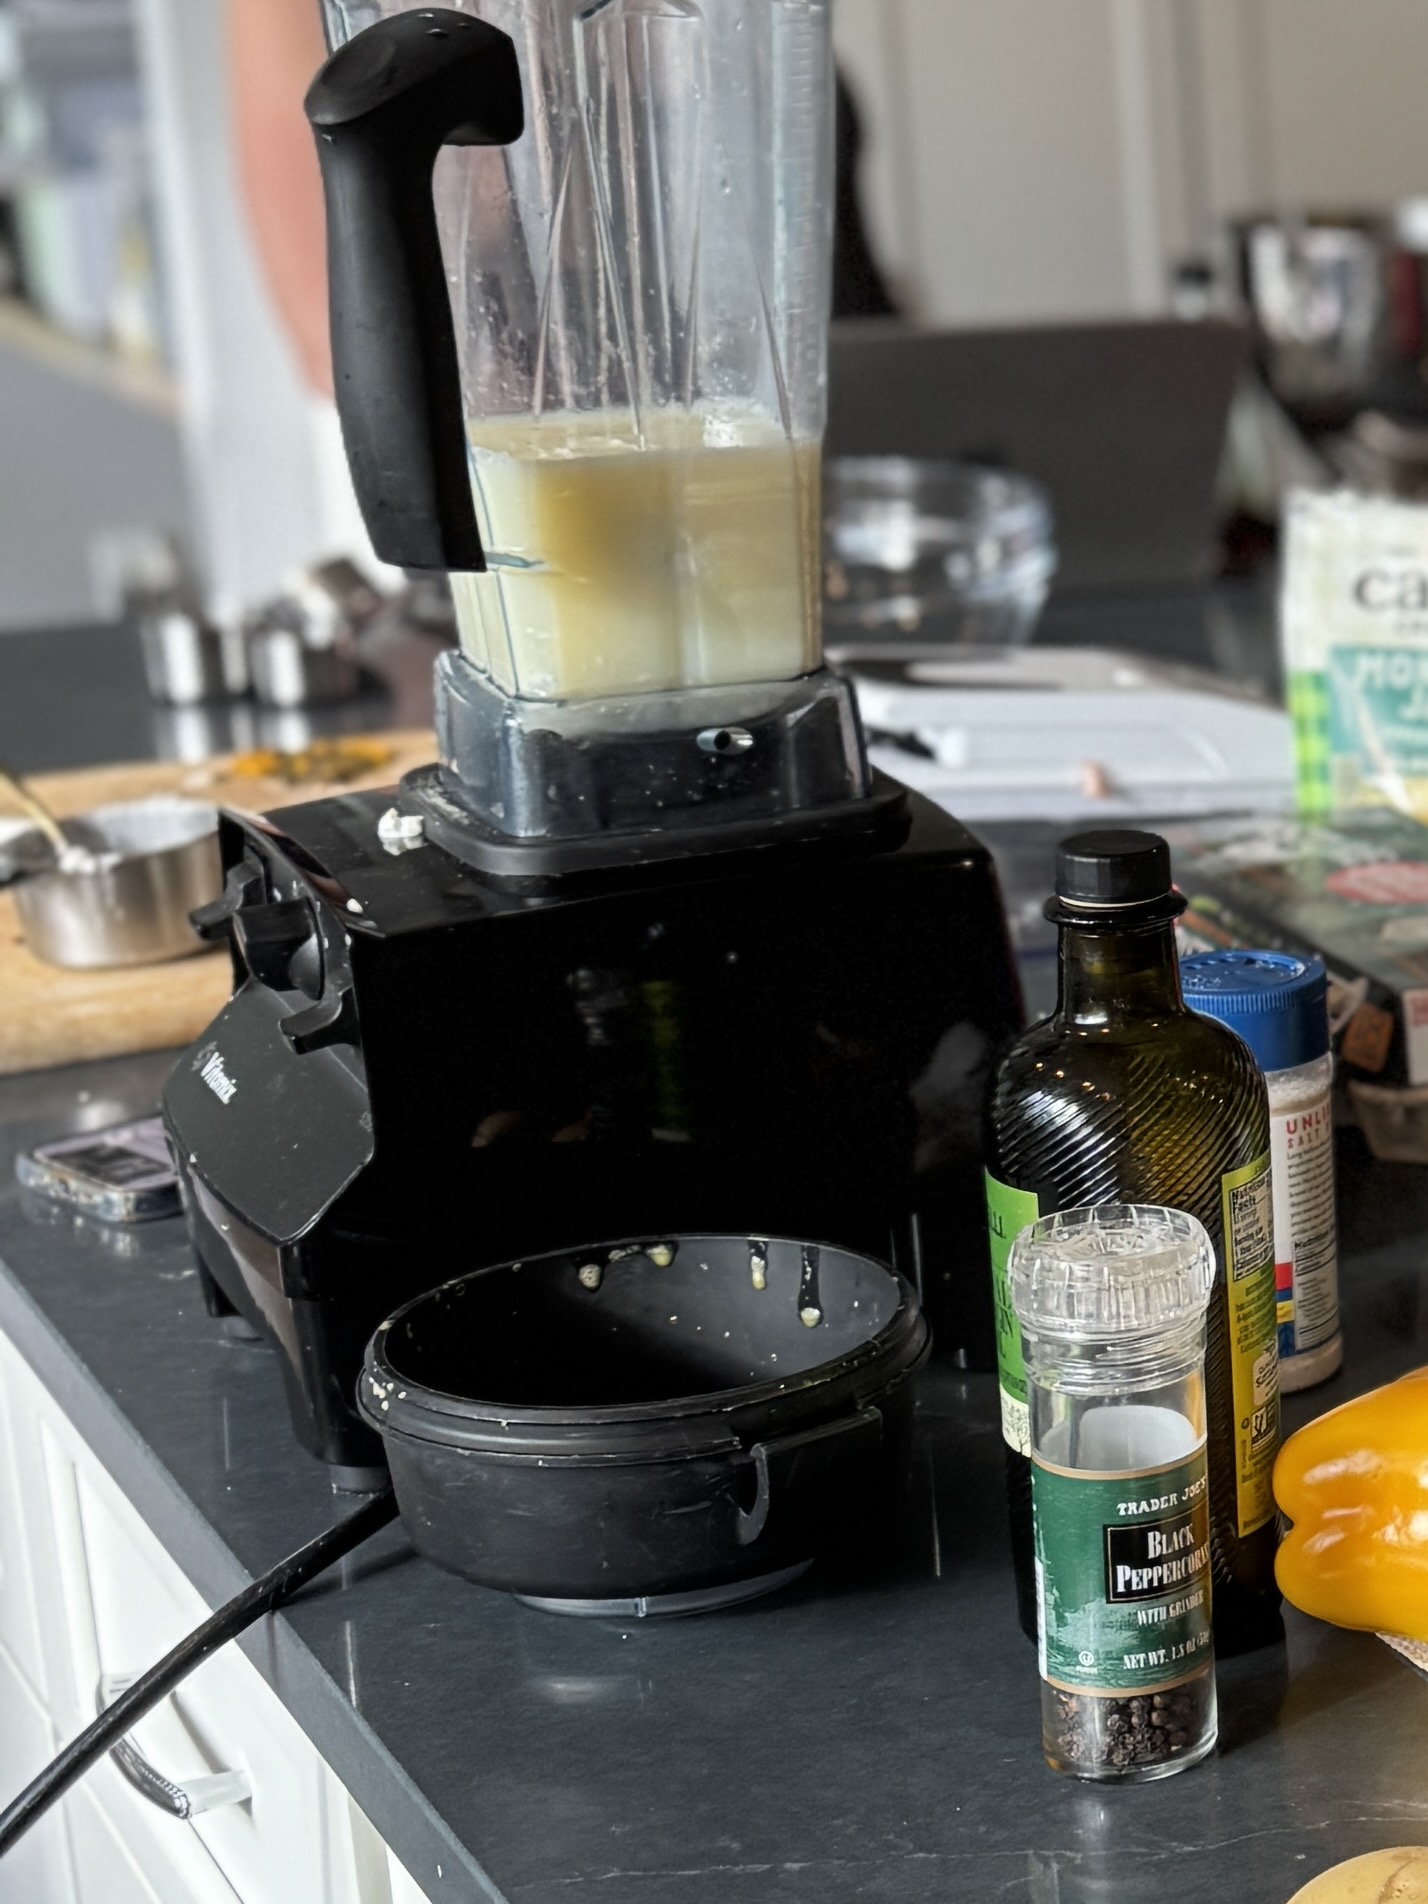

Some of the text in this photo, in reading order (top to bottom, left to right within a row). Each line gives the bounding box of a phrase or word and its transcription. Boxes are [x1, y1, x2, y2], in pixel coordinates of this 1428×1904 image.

[1117, 1493, 1178, 1516] TRADER
[1147, 1523, 1194, 1560] BLACK
[1137, 1590, 1204, 1626] WITH GRINDER
[1123, 1654, 1145, 1670] NET
[1148, 1650, 1169, 1665] WT.
